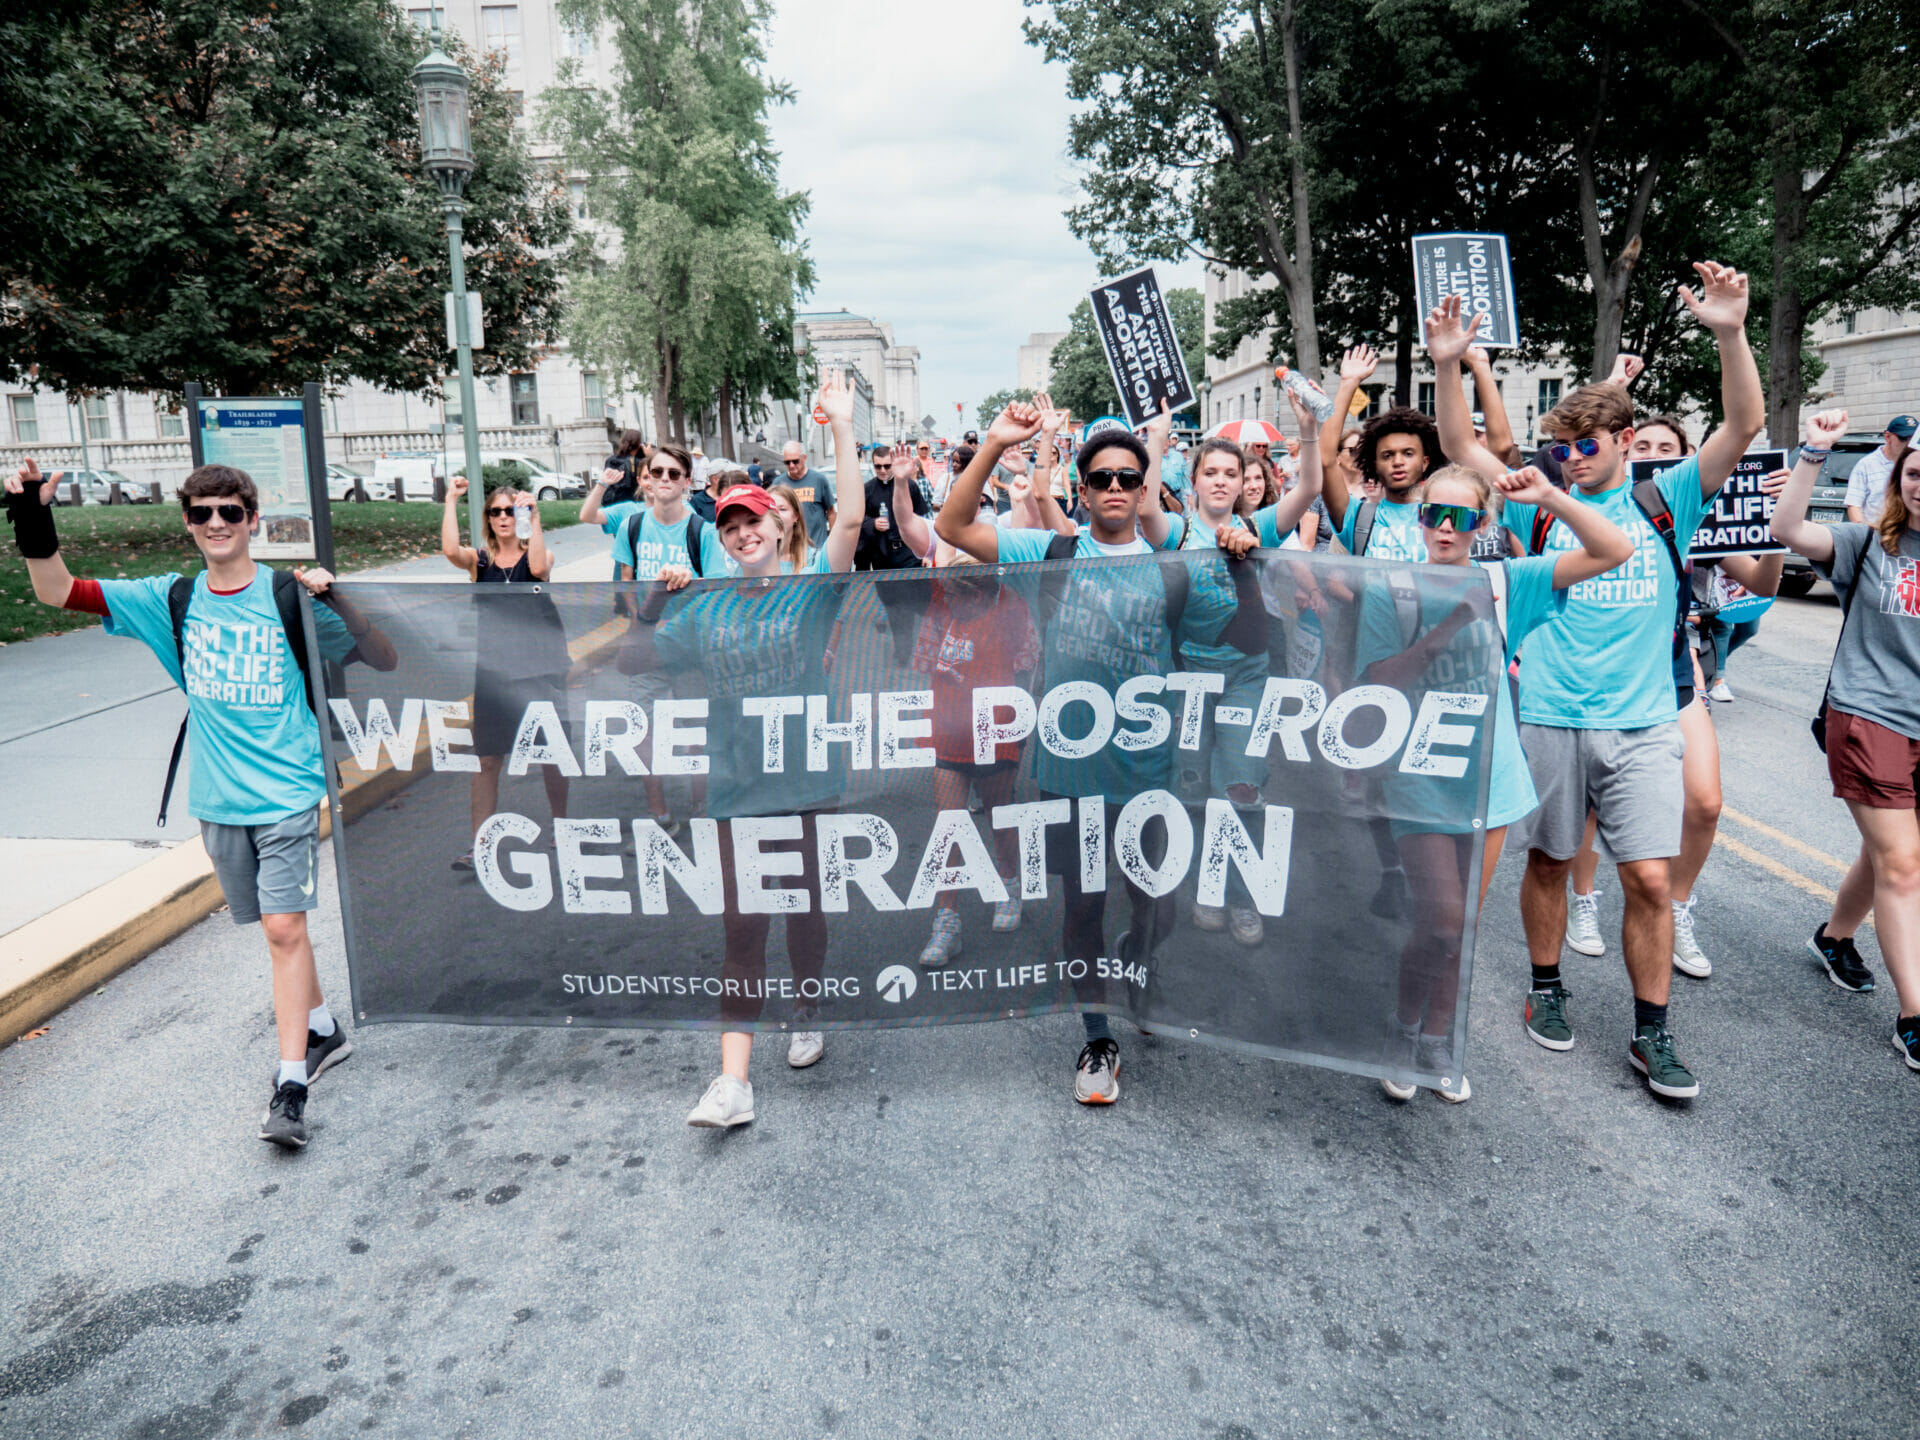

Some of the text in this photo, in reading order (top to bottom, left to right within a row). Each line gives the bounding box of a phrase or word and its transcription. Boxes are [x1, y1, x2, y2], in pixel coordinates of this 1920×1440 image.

[1433, 246, 1446, 258] IS
[1450, 263, 1472, 317] ANTI-
[1467, 240, 1494, 341] ABORTION
[1103, 288, 1157, 418] ABORTION
[1128, 313, 1158, 380] ANTI-
[1136, 283, 1178, 397] THE FUTURE IS
[1153, 301, 1183, 383] STUDENTSFORLIFE.ORG
[1092, 420, 1111, 432] PRAY
[1723, 473, 1770, 494] THE
[1707, 495, 1777, 522] -LIFE
[641, 542, 663, 560] AM
[1468, 540, 1500, 558] LIFE
[1568, 578, 1658, 600] ERATION
[186, 622, 285, 654] AM THE
[184, 671, 283, 705] ENERATION
[328, 672, 1489, 777] WE ARE THE POST-ROE
[474, 789, 1294, 916] GENERATION
[562, 957, 1148, 999] STUDENTSFORLIFE.ORG TEXT LIFE TO 53445
